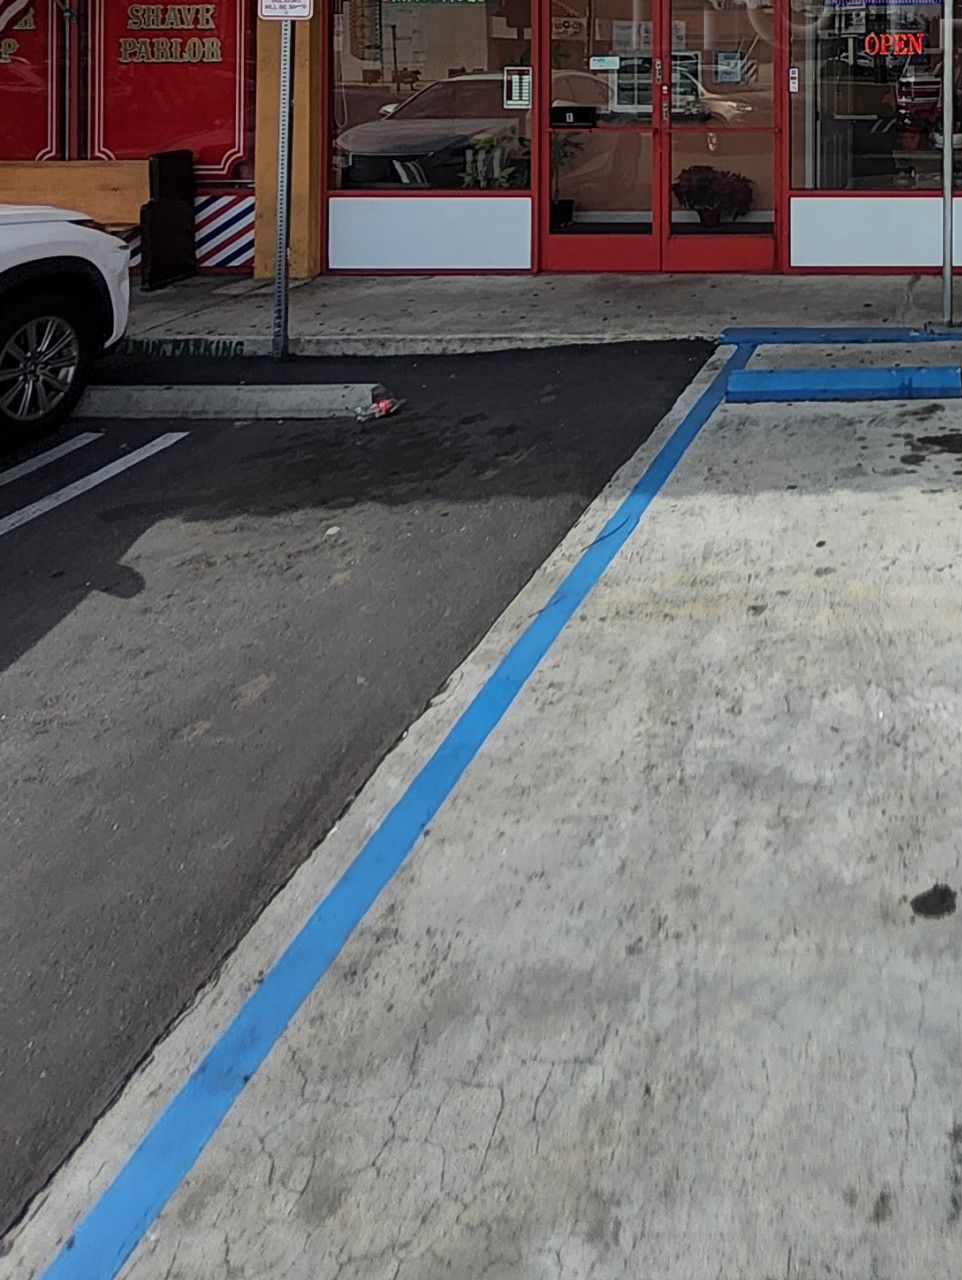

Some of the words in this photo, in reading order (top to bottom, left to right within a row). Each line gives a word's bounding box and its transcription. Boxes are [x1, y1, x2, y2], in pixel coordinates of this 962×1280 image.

[127, 4, 216, 30] SHAVE
[119, 37, 223, 63] PARLOR
[864, 32, 925, 56] OPEN
